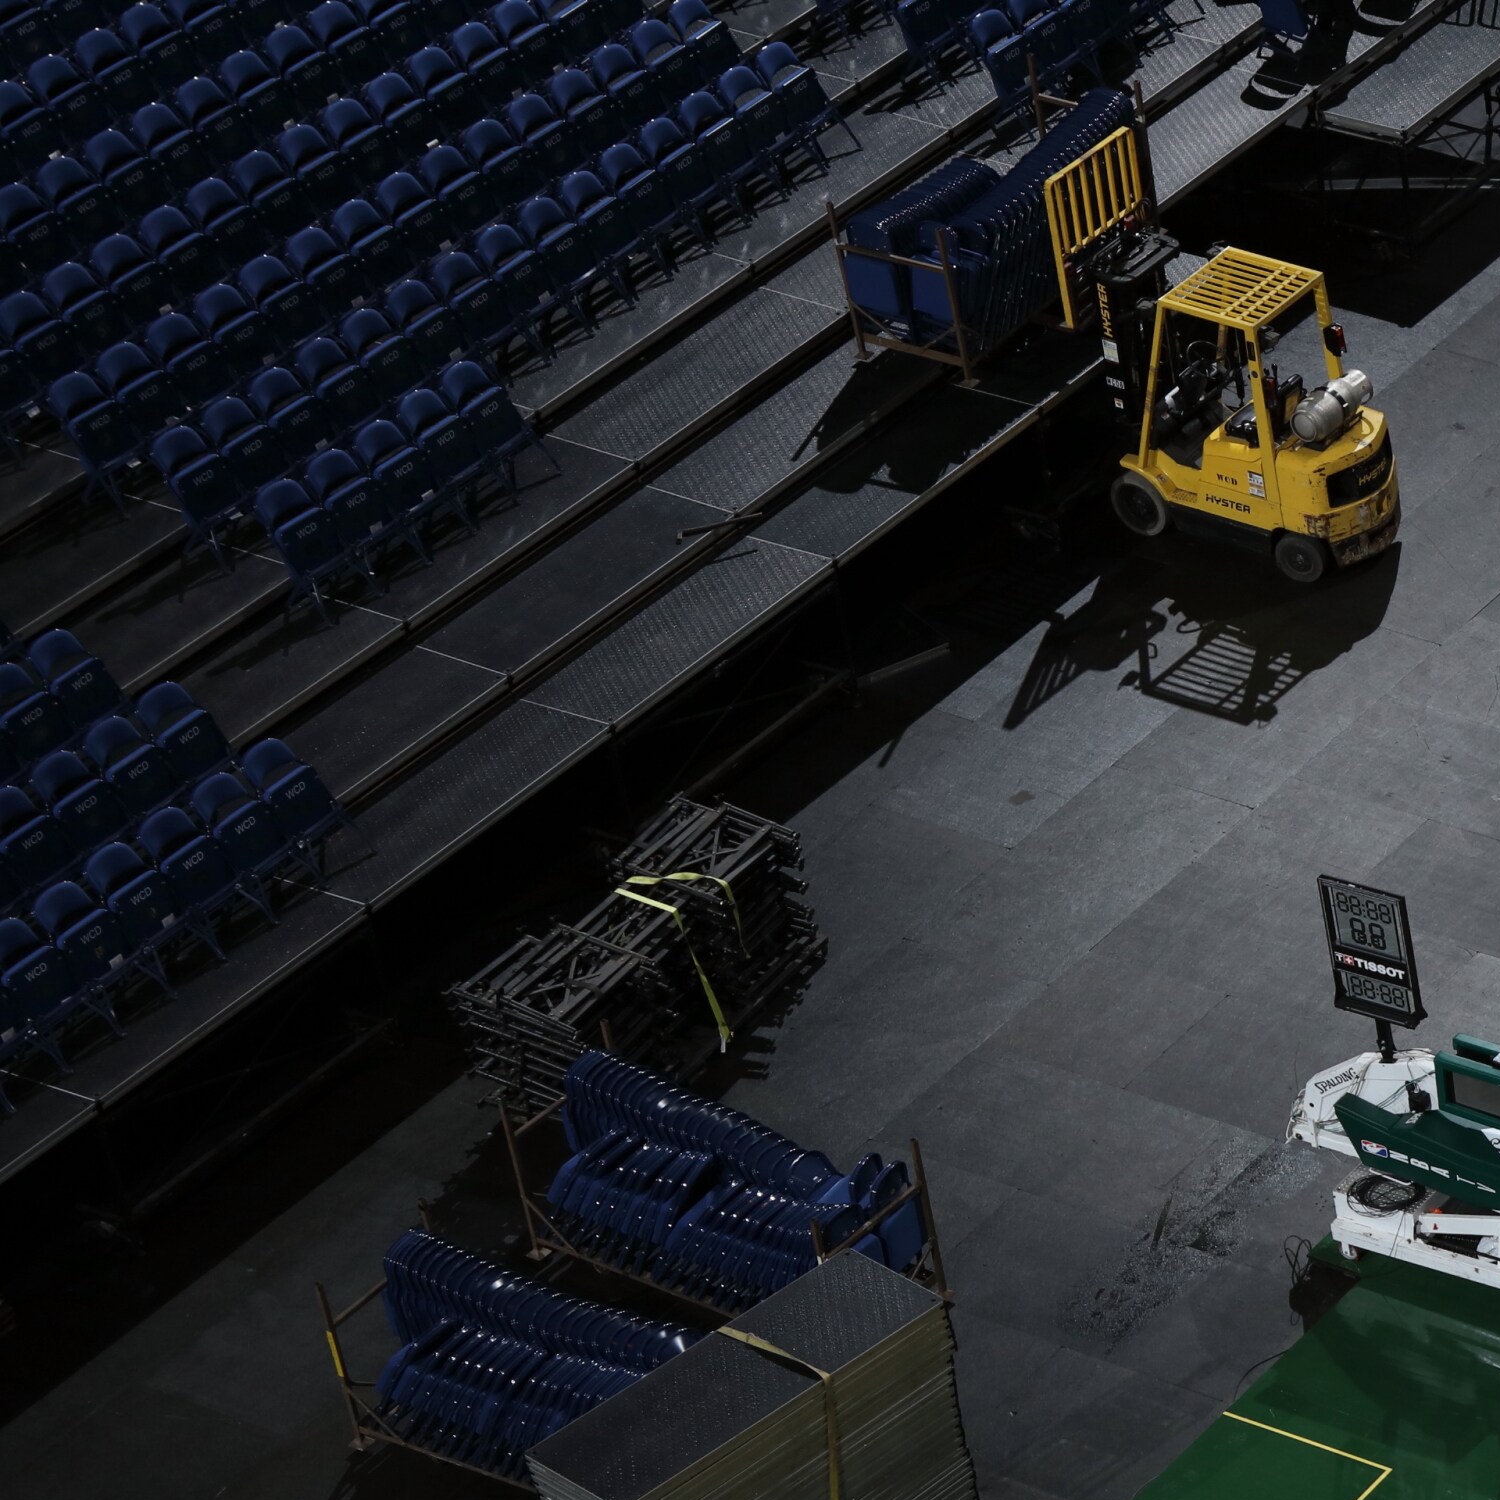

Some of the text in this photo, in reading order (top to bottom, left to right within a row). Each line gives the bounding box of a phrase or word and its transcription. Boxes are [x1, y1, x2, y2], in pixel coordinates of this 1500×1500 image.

[1096, 282, 1114, 338] HYSTER
[1216, 473, 1238, 486] WCD
[1205, 493, 1251, 514] HYSTER
[1336, 891, 1392, 924] 88:88
[1354, 957, 1405, 980] TISSOT
[1350, 976, 1405, 1008] 88:88
[1315, 1067, 1359, 1094] SPALDING
[1389, 1149, 1451, 1179] NBA
